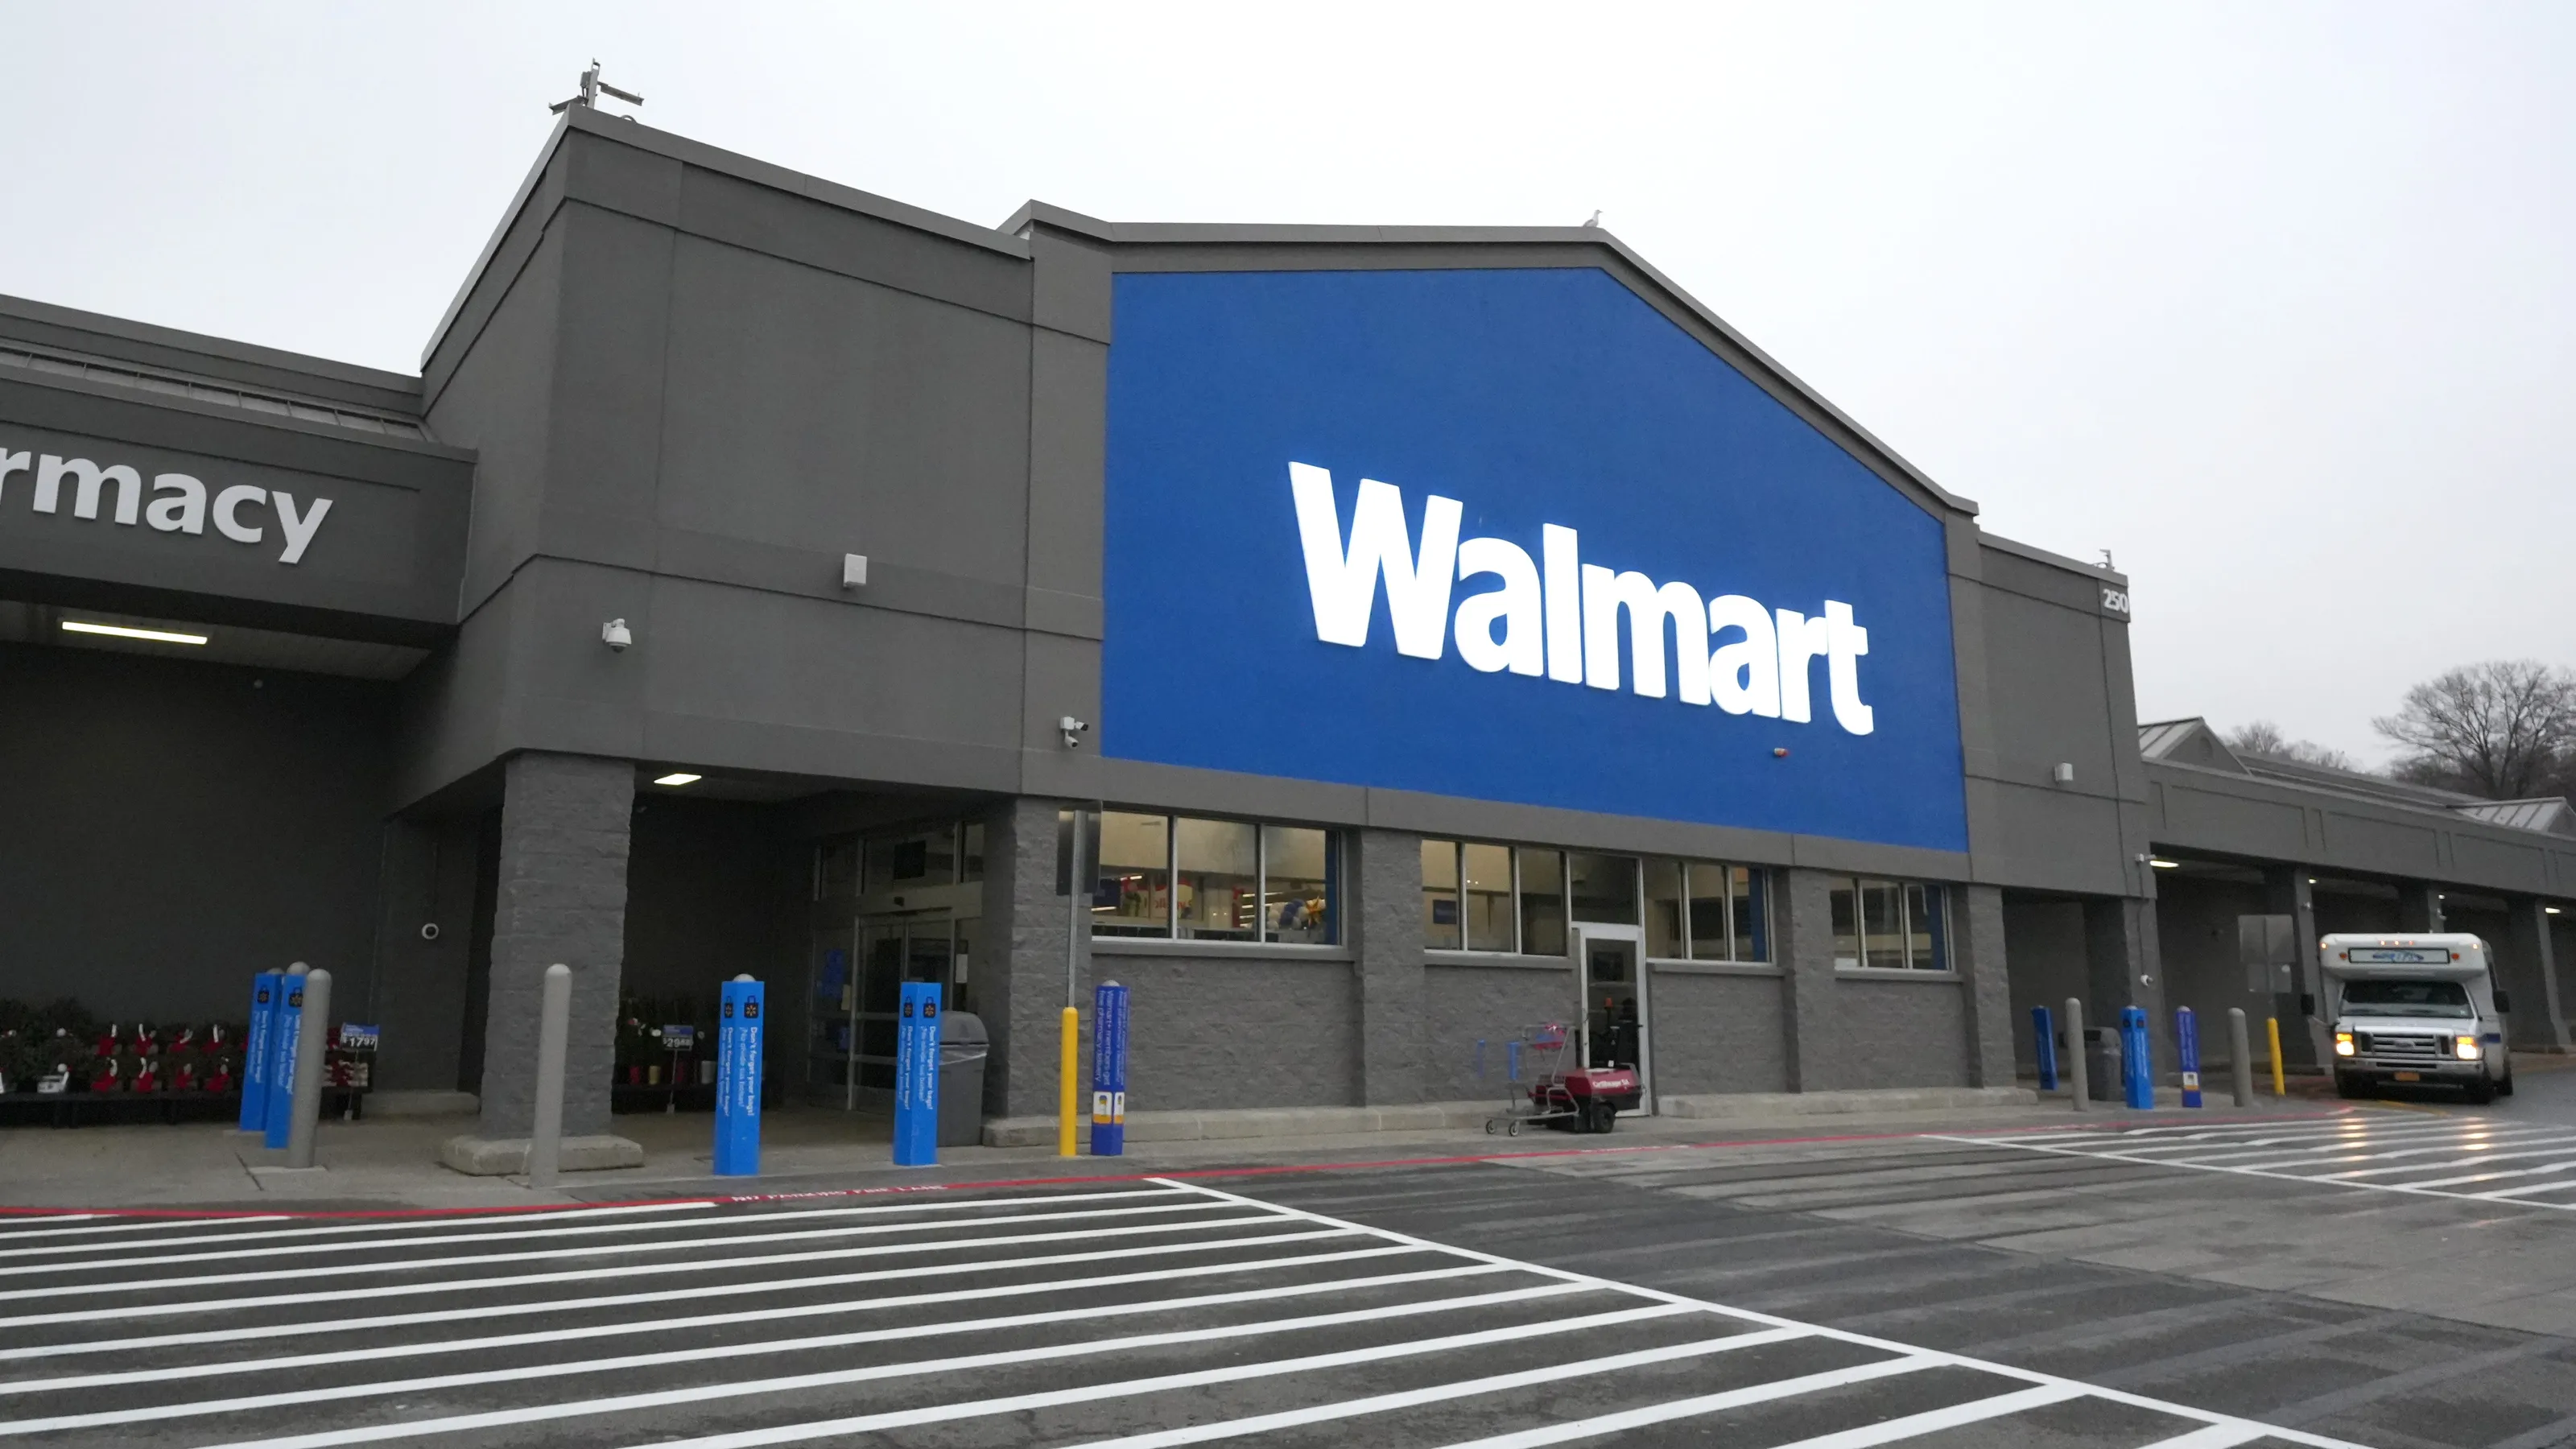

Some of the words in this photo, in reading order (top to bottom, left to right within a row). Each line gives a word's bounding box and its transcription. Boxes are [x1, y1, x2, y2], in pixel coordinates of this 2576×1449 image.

[0, 448, 333, 564] rmacy
[1289, 461, 1873, 736] Walmart
[2103, 588, 2129, 613] 250
[748, 1050, 757, 1074] forget
